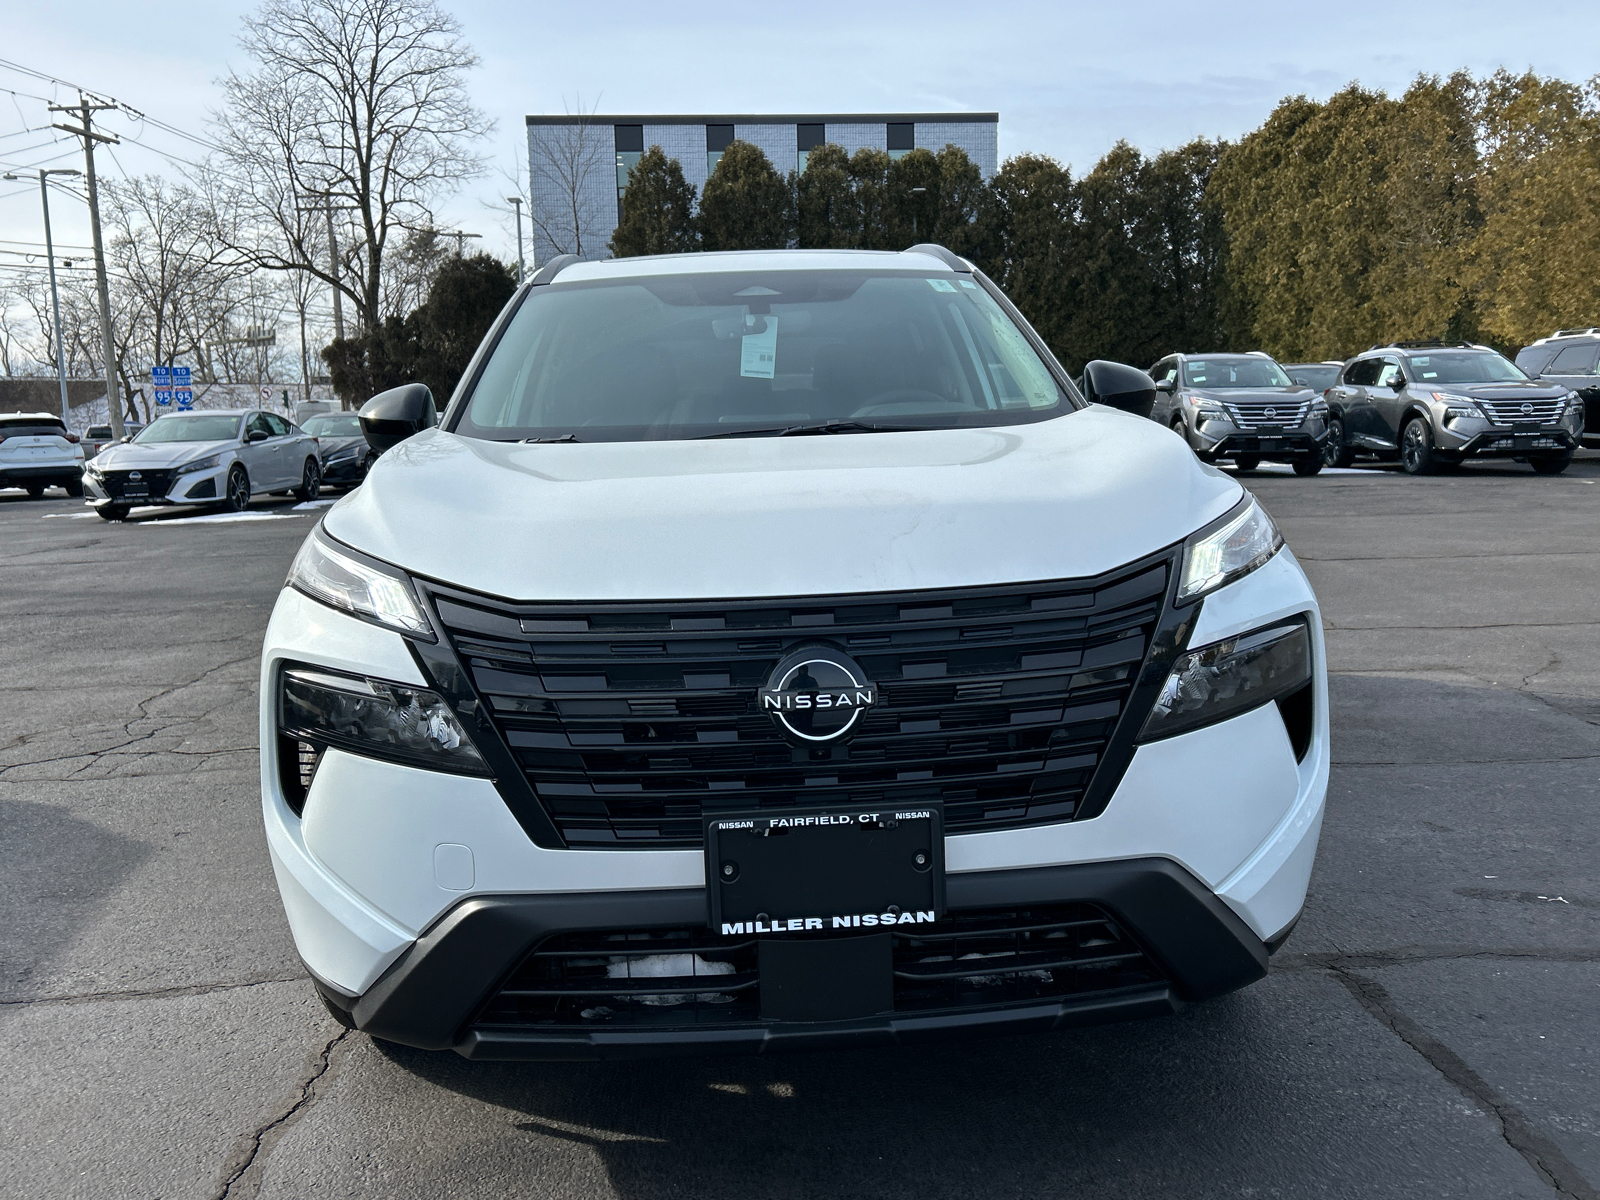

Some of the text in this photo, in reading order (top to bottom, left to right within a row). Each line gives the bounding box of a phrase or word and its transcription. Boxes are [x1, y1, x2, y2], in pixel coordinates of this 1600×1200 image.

[174, 377, 191, 385] SOUTH
[157, 392, 170, 402] 95
[177, 392, 191, 403] 95
[764, 690, 872, 709] NISSAN
[769, 813, 880, 828] FAIRFIELD, CT
[895, 811, 930, 820] NISSAN
[718, 821, 754, 830] NISSAN
[721, 910, 935, 935] MILLER NISSAN
